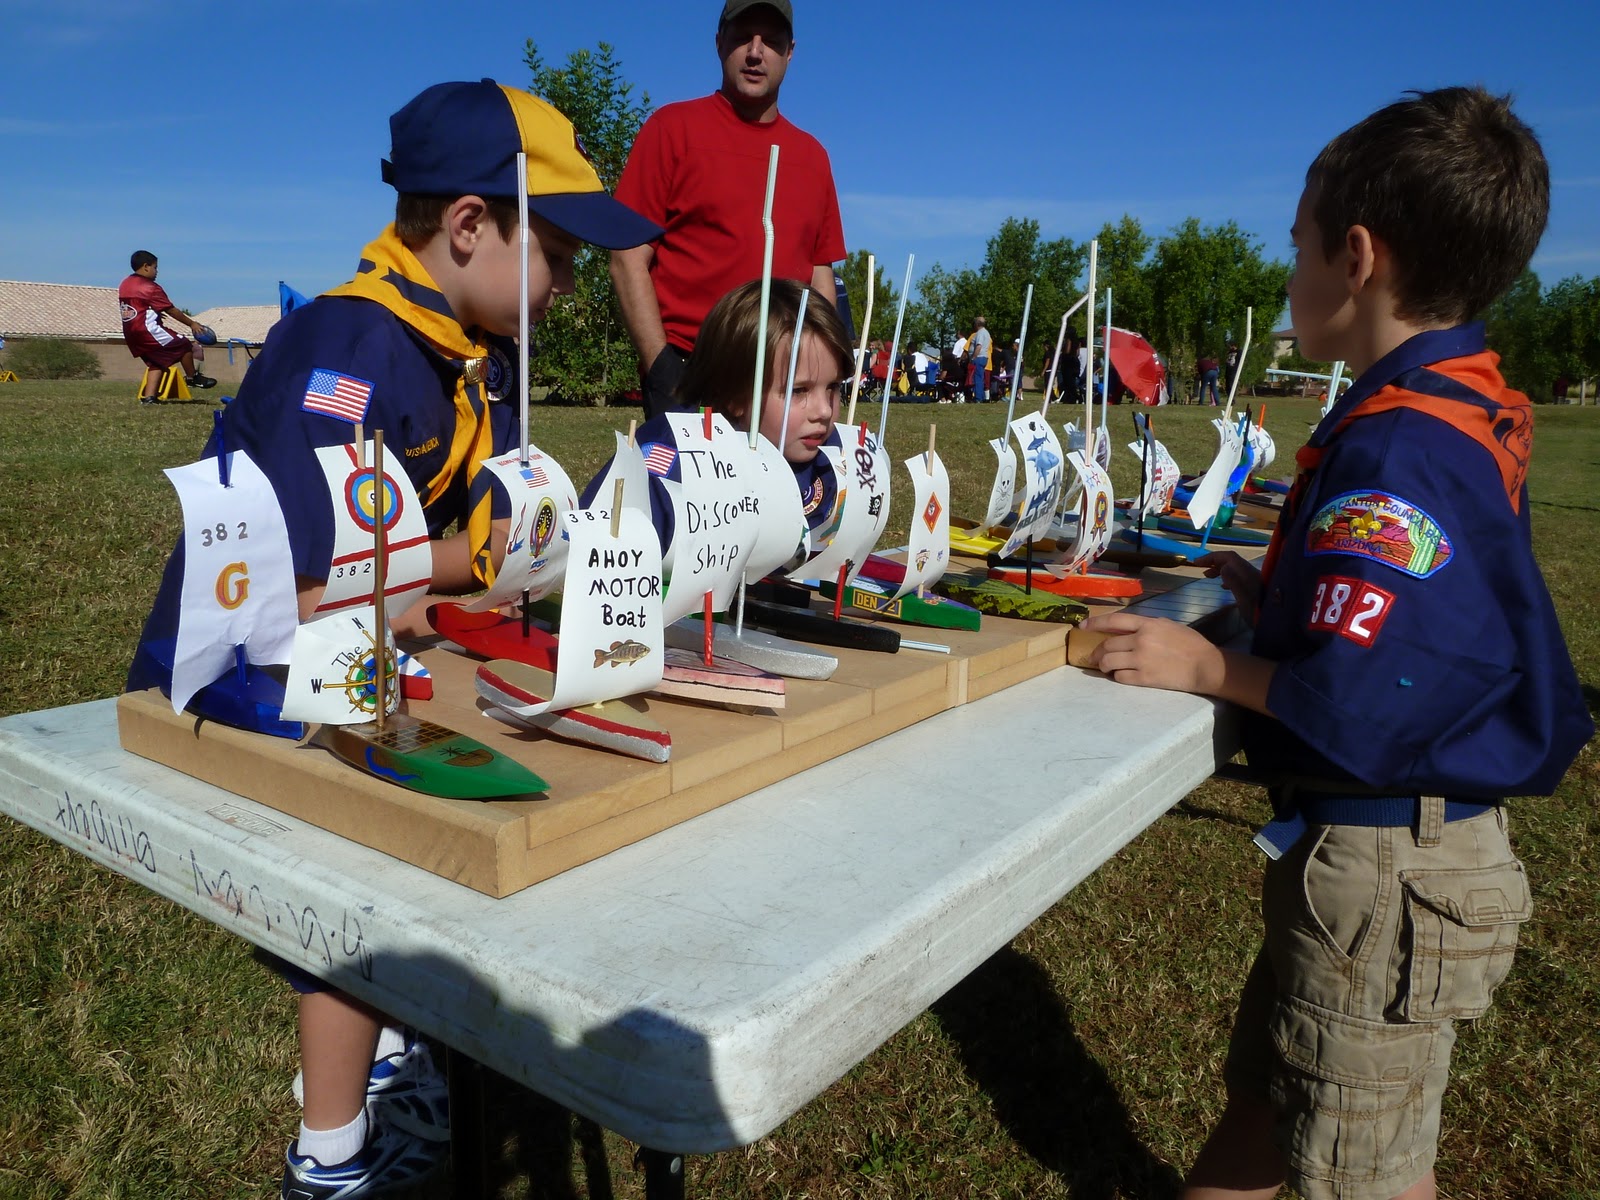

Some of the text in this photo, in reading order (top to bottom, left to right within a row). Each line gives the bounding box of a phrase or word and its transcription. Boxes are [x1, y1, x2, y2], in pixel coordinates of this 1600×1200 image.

[678, 450, 736, 479] The
[588, 547, 643, 569] AHOY
[215, 561, 250, 611] G
[588, 575, 660, 598] MOTOR
[856, 592, 878, 610] DEN
[1311, 583, 1385, 639] 382
[601, 603, 646, 628] Boat
[331, 646, 363, 667] The
[311, 678, 322, 693] W
